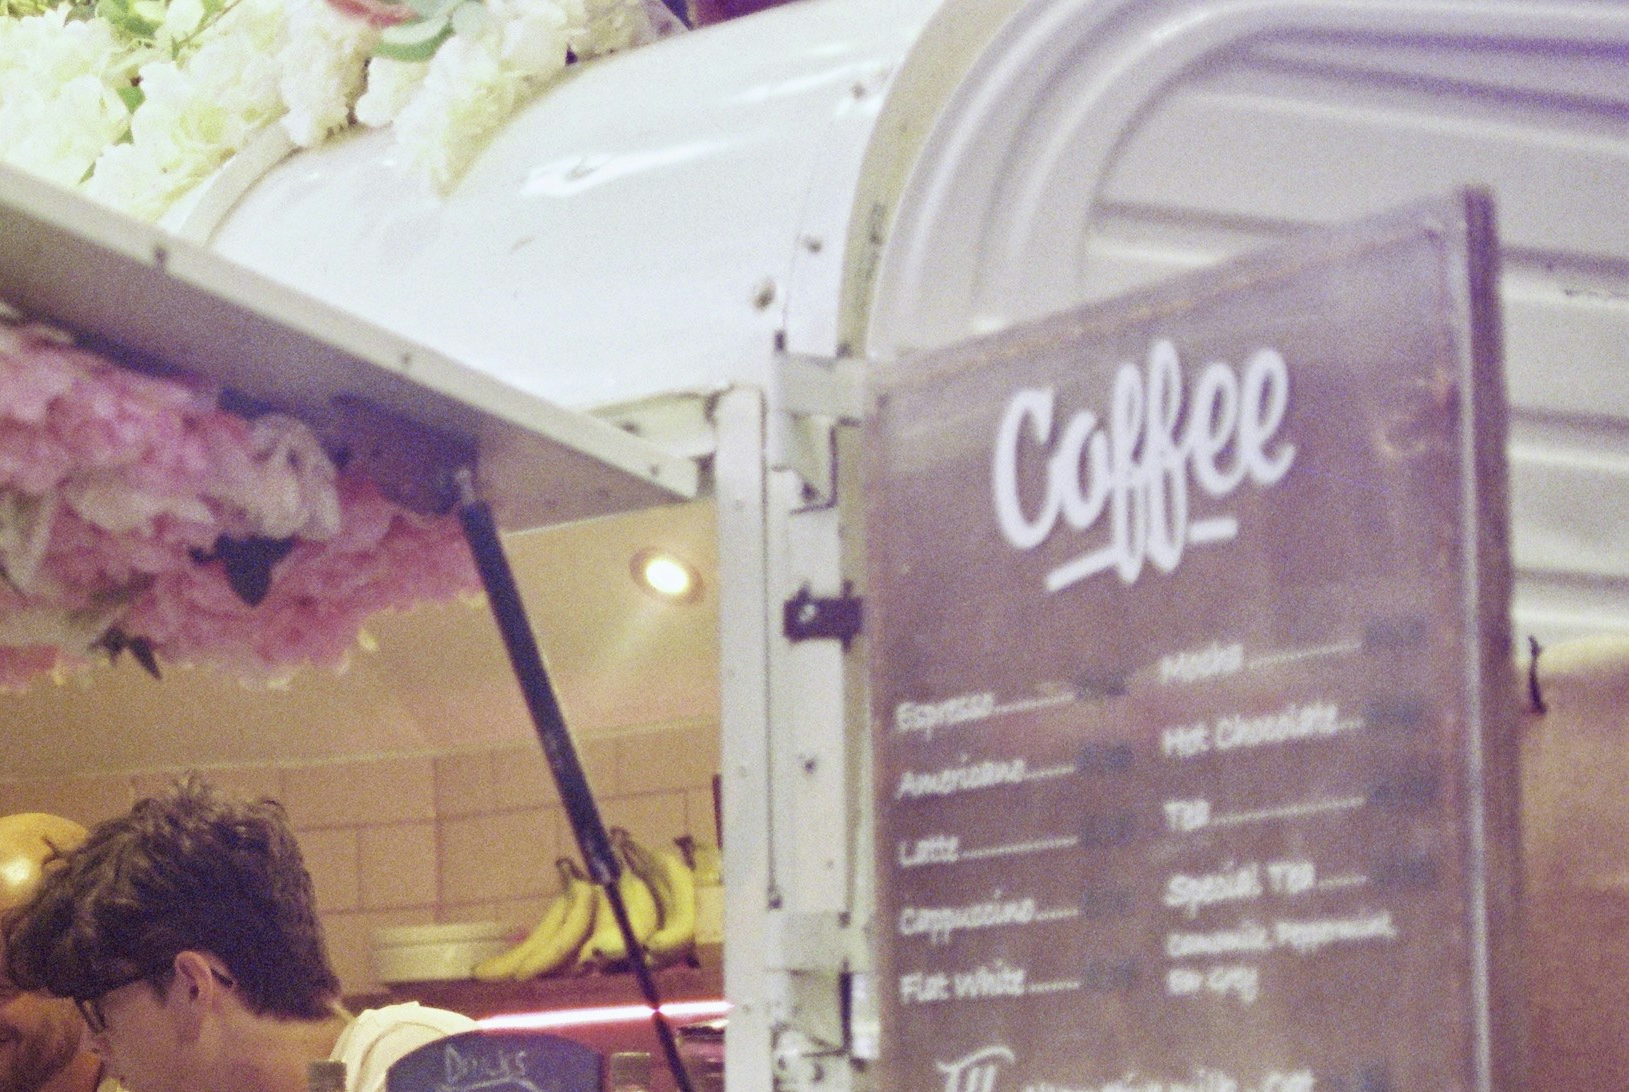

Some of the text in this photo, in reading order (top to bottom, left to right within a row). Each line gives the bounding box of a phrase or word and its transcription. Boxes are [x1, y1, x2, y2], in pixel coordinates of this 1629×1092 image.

[992, 338, 1297, 584] Coffee
[895, 692, 994, 741] Espresso
[897, 752, 1027, 799] Americano
[899, 834, 960, 867] Latte
[899, 889, 1035, 944] Cappuccino
[953, 957, 1026, 997] White
